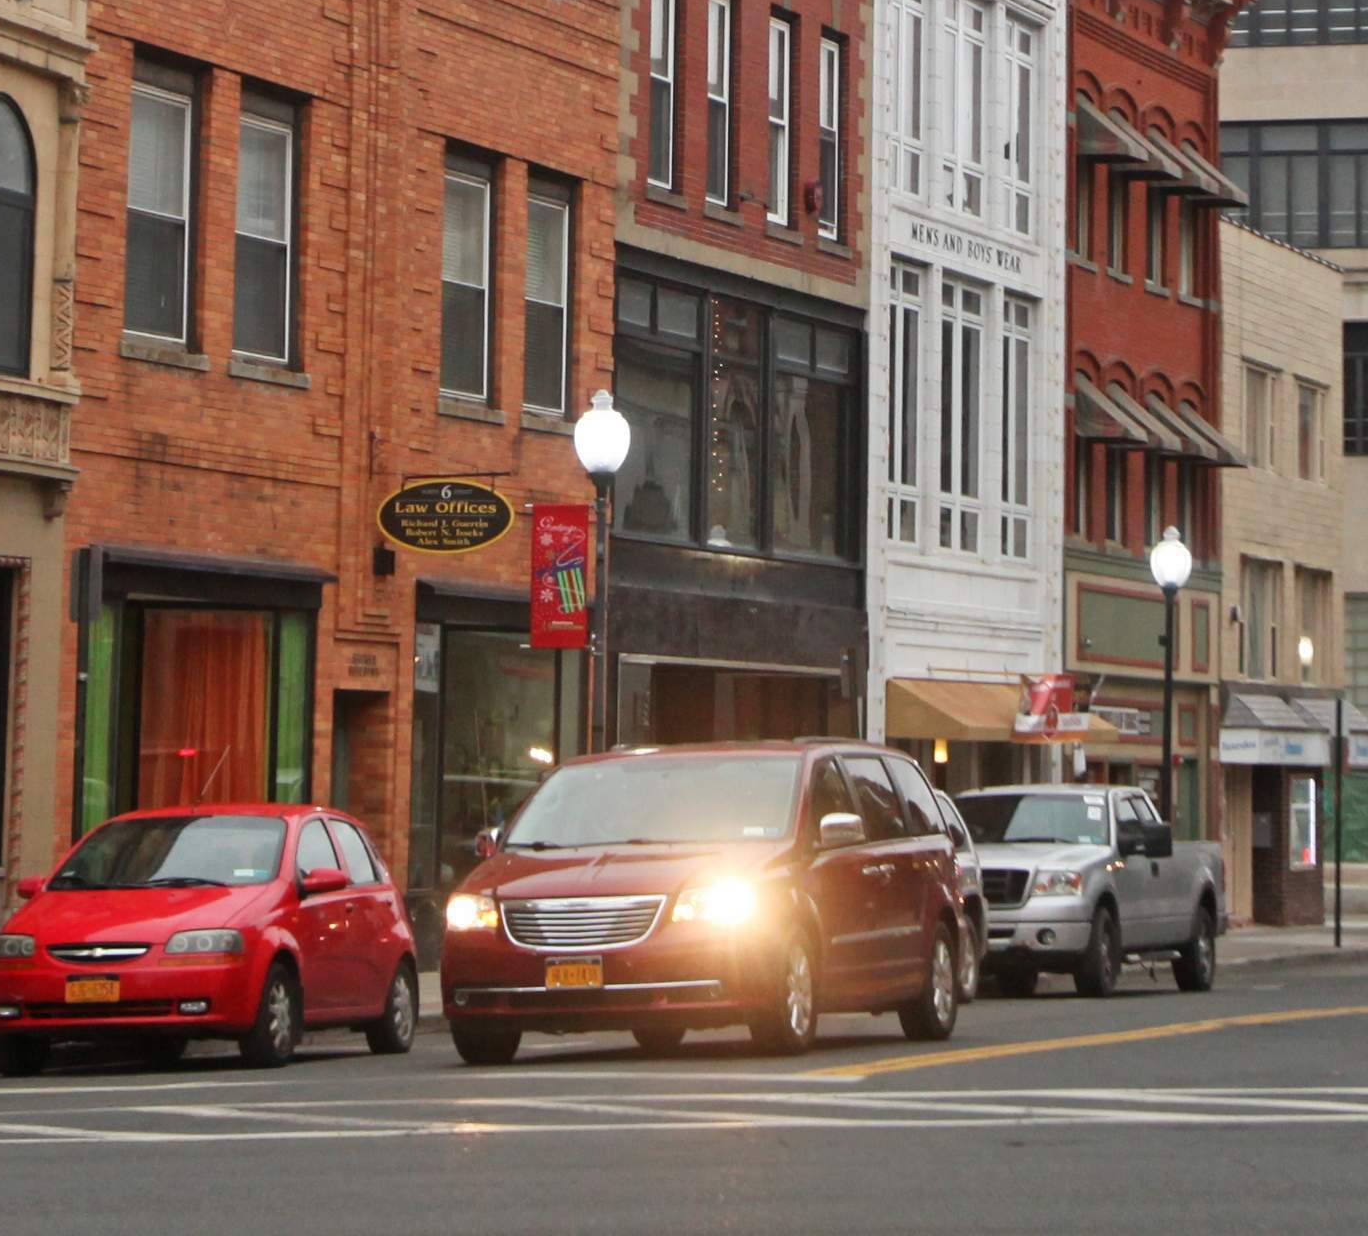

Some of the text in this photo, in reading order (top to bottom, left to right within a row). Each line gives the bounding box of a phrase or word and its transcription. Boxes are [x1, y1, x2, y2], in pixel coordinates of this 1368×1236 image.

[943, 233, 963, 254] AND
[996, 248, 1021, 273] WEAR
[440, 484, 453, 499] 6
[395, 500, 497, 514] Law Offices
